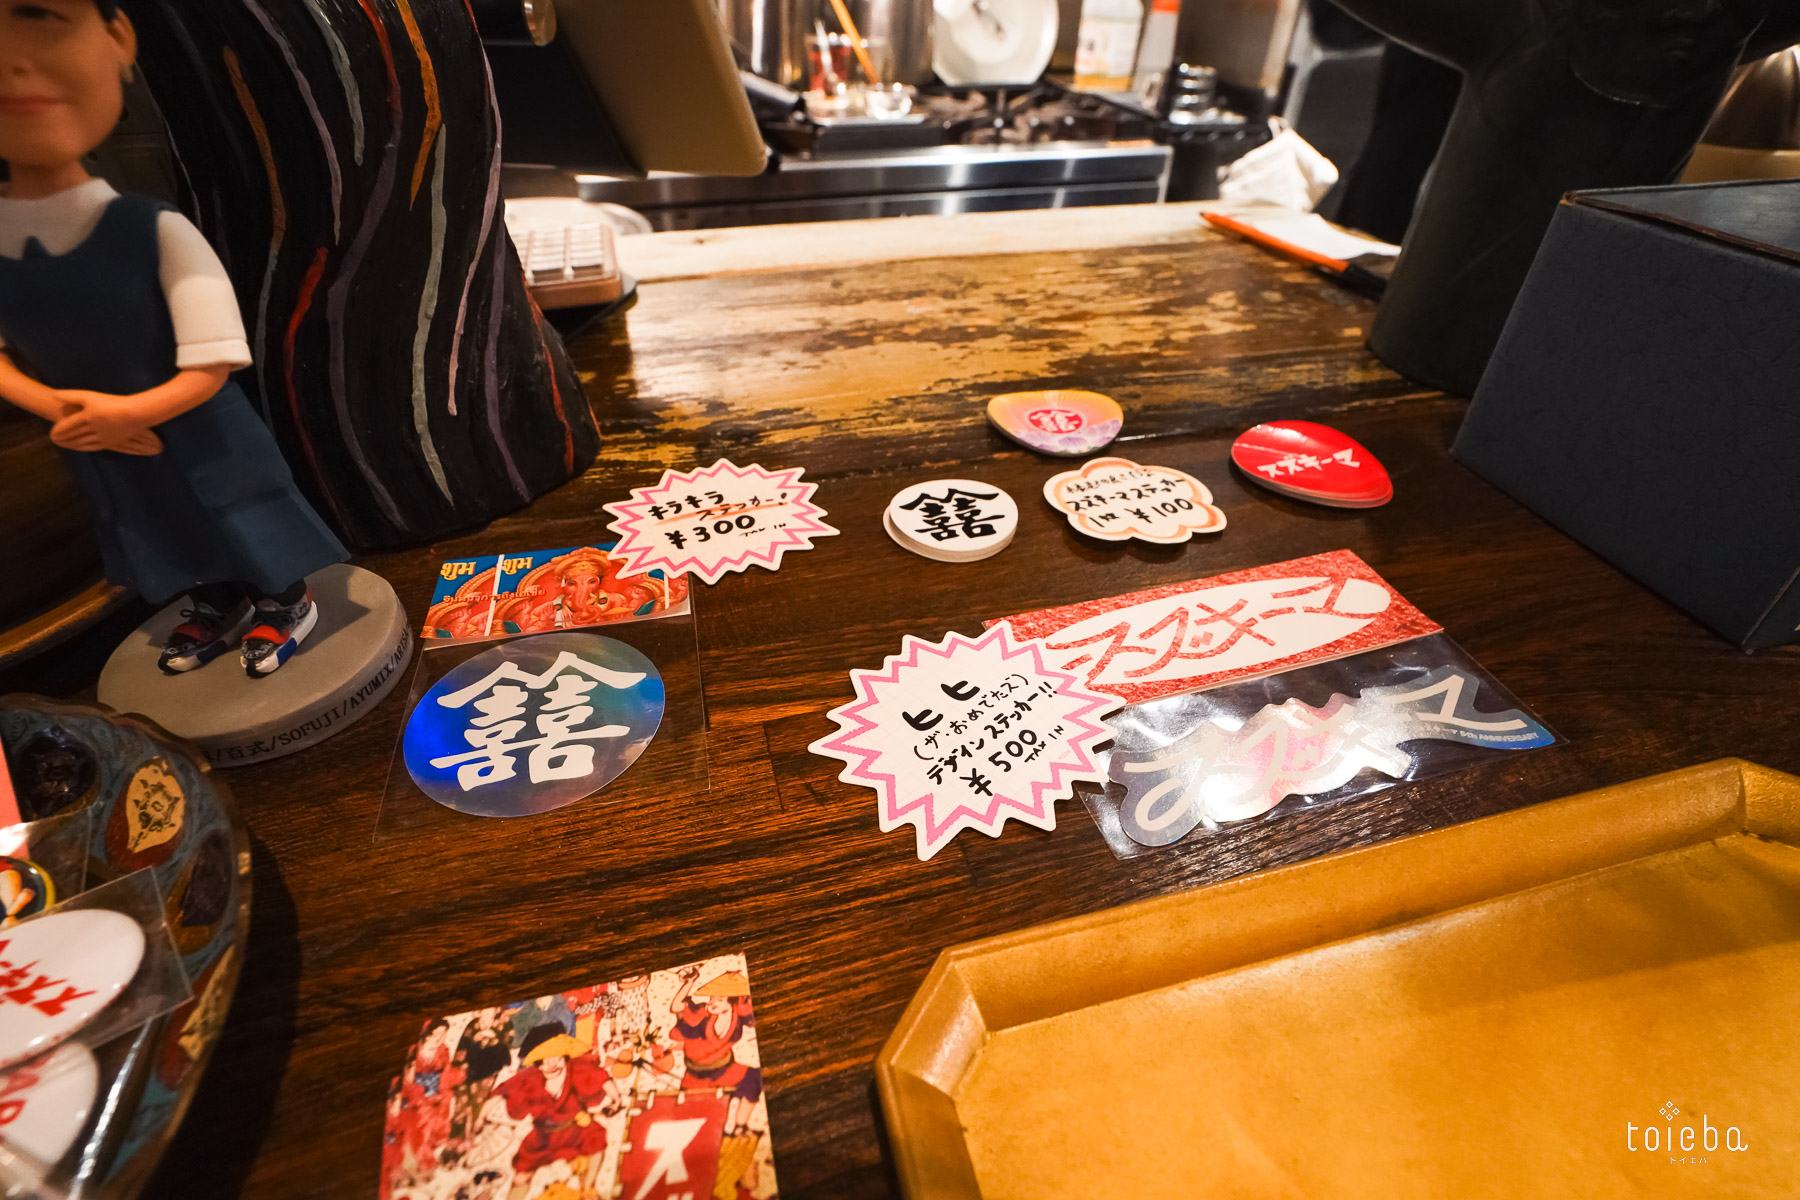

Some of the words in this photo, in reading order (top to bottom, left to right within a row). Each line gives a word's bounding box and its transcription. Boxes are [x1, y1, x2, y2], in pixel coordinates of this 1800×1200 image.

[648, 491, 725, 520] キラキラ
[664, 515, 756, 550] ¥300
[1024, 741, 1047, 763] TAX
[1047, 725, 1065, 740] IN
